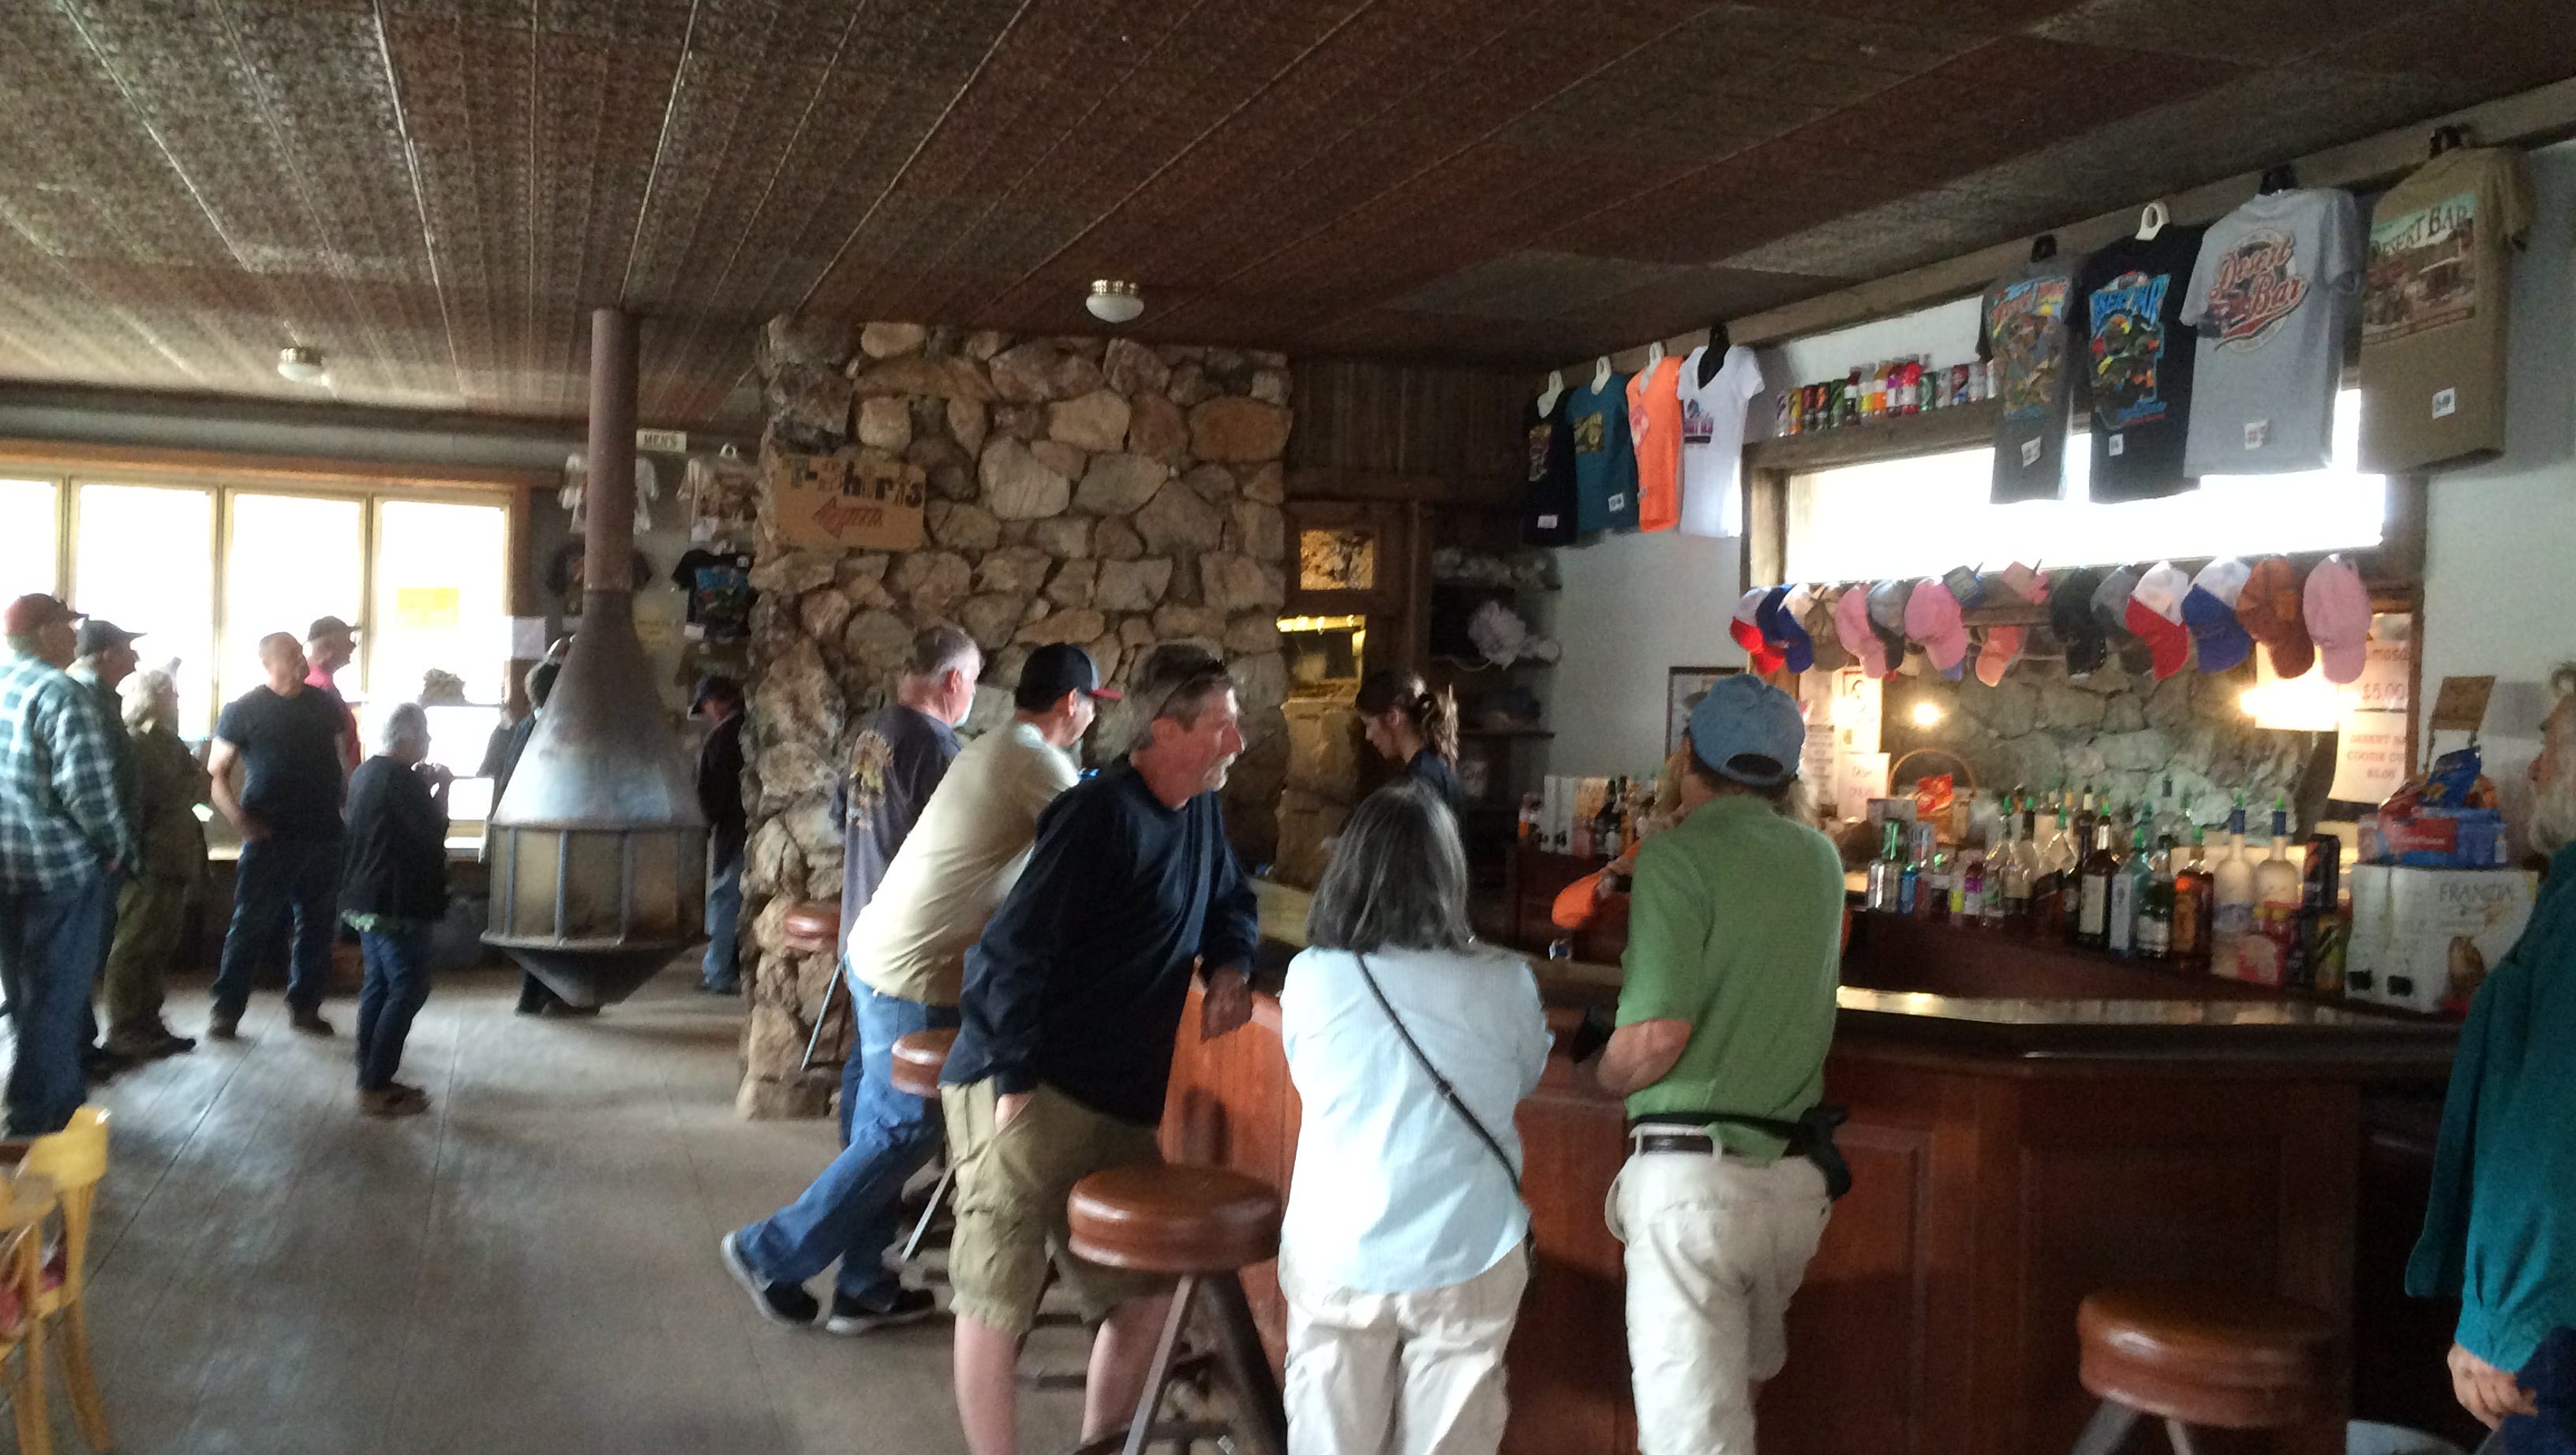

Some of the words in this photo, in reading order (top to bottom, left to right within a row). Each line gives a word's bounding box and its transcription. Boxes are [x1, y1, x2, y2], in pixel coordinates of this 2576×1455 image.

[2216, 236, 2294, 293] Desert
[2248, 271, 2308, 319] Bar
[642, 432, 677, 450] MEN'S
